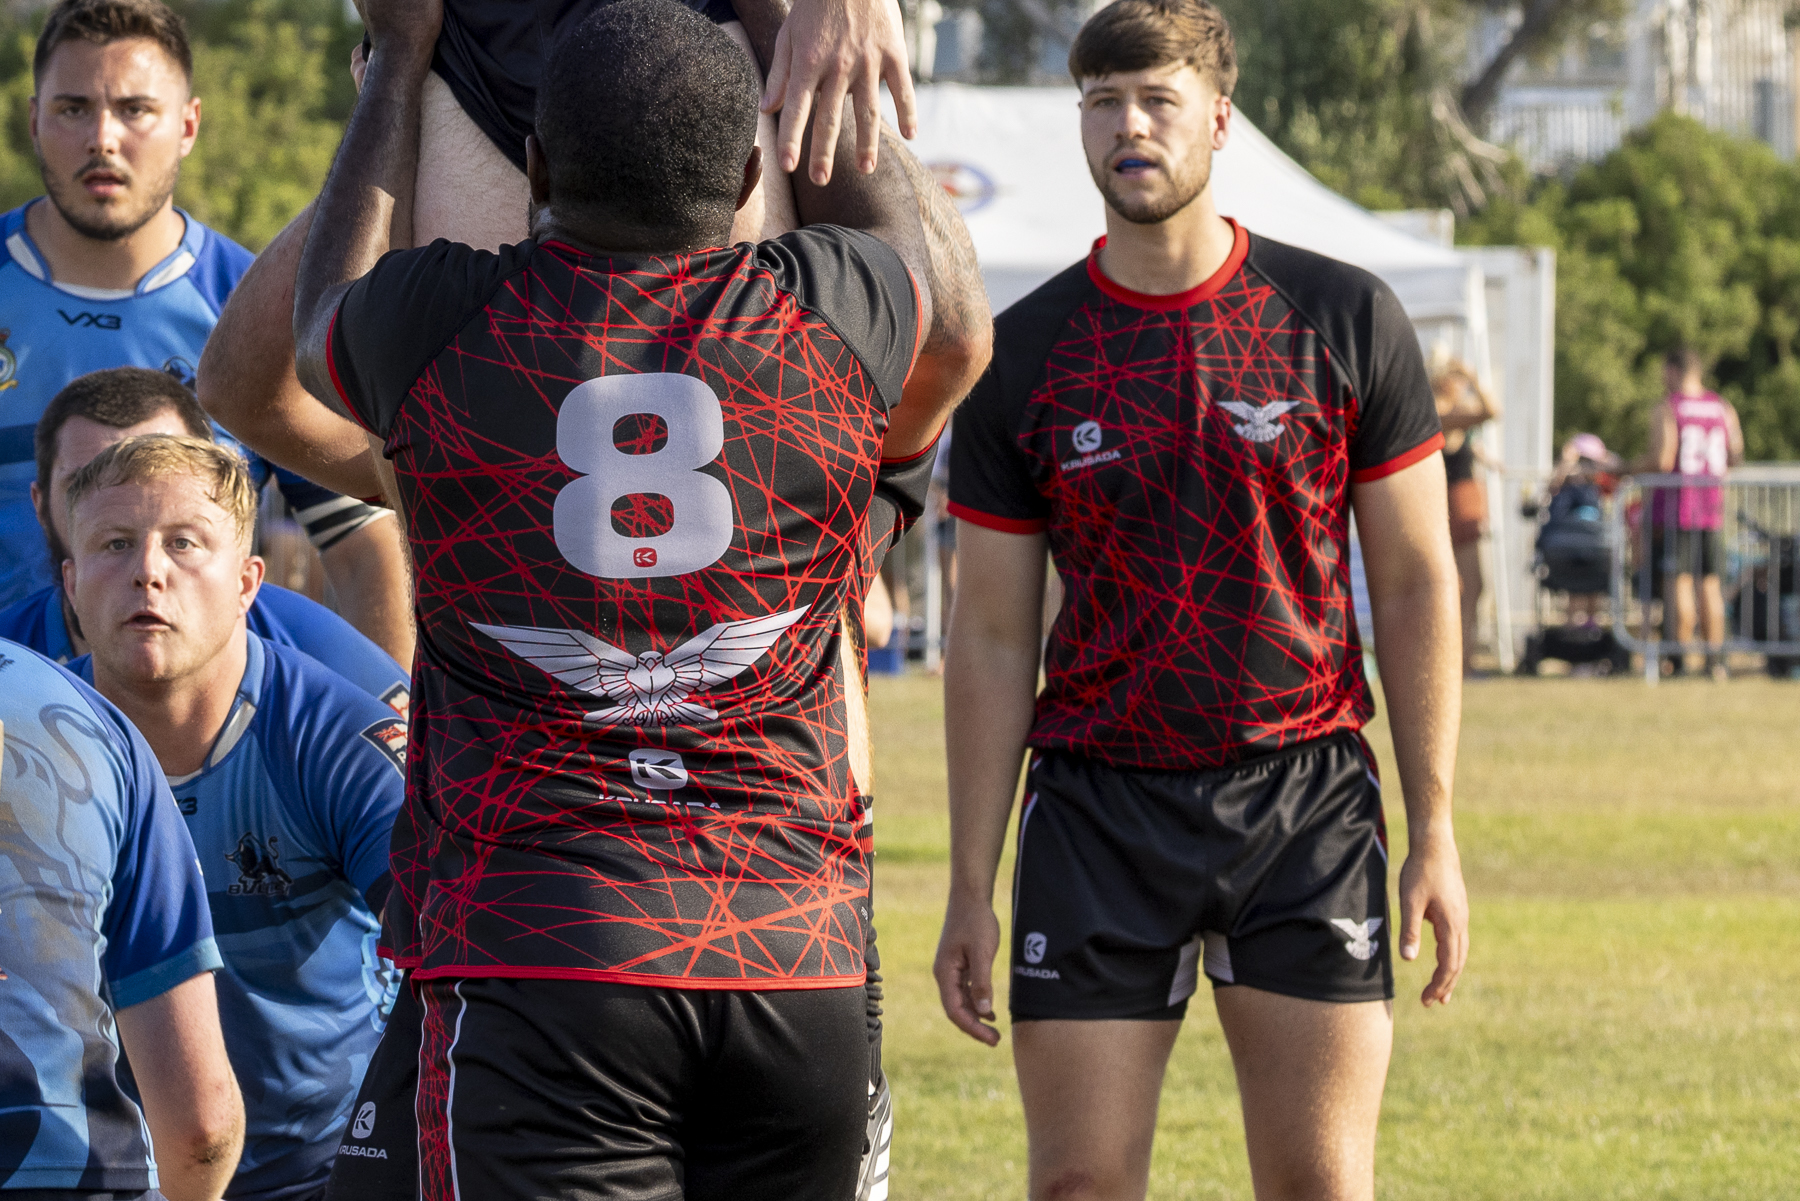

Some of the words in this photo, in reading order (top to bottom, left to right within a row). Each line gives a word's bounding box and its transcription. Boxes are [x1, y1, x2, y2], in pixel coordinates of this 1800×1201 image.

[57, 309, 122, 331] VX3
[1061, 449, 1122, 472] KRUSADA
[553, 372, 734, 579] 8
